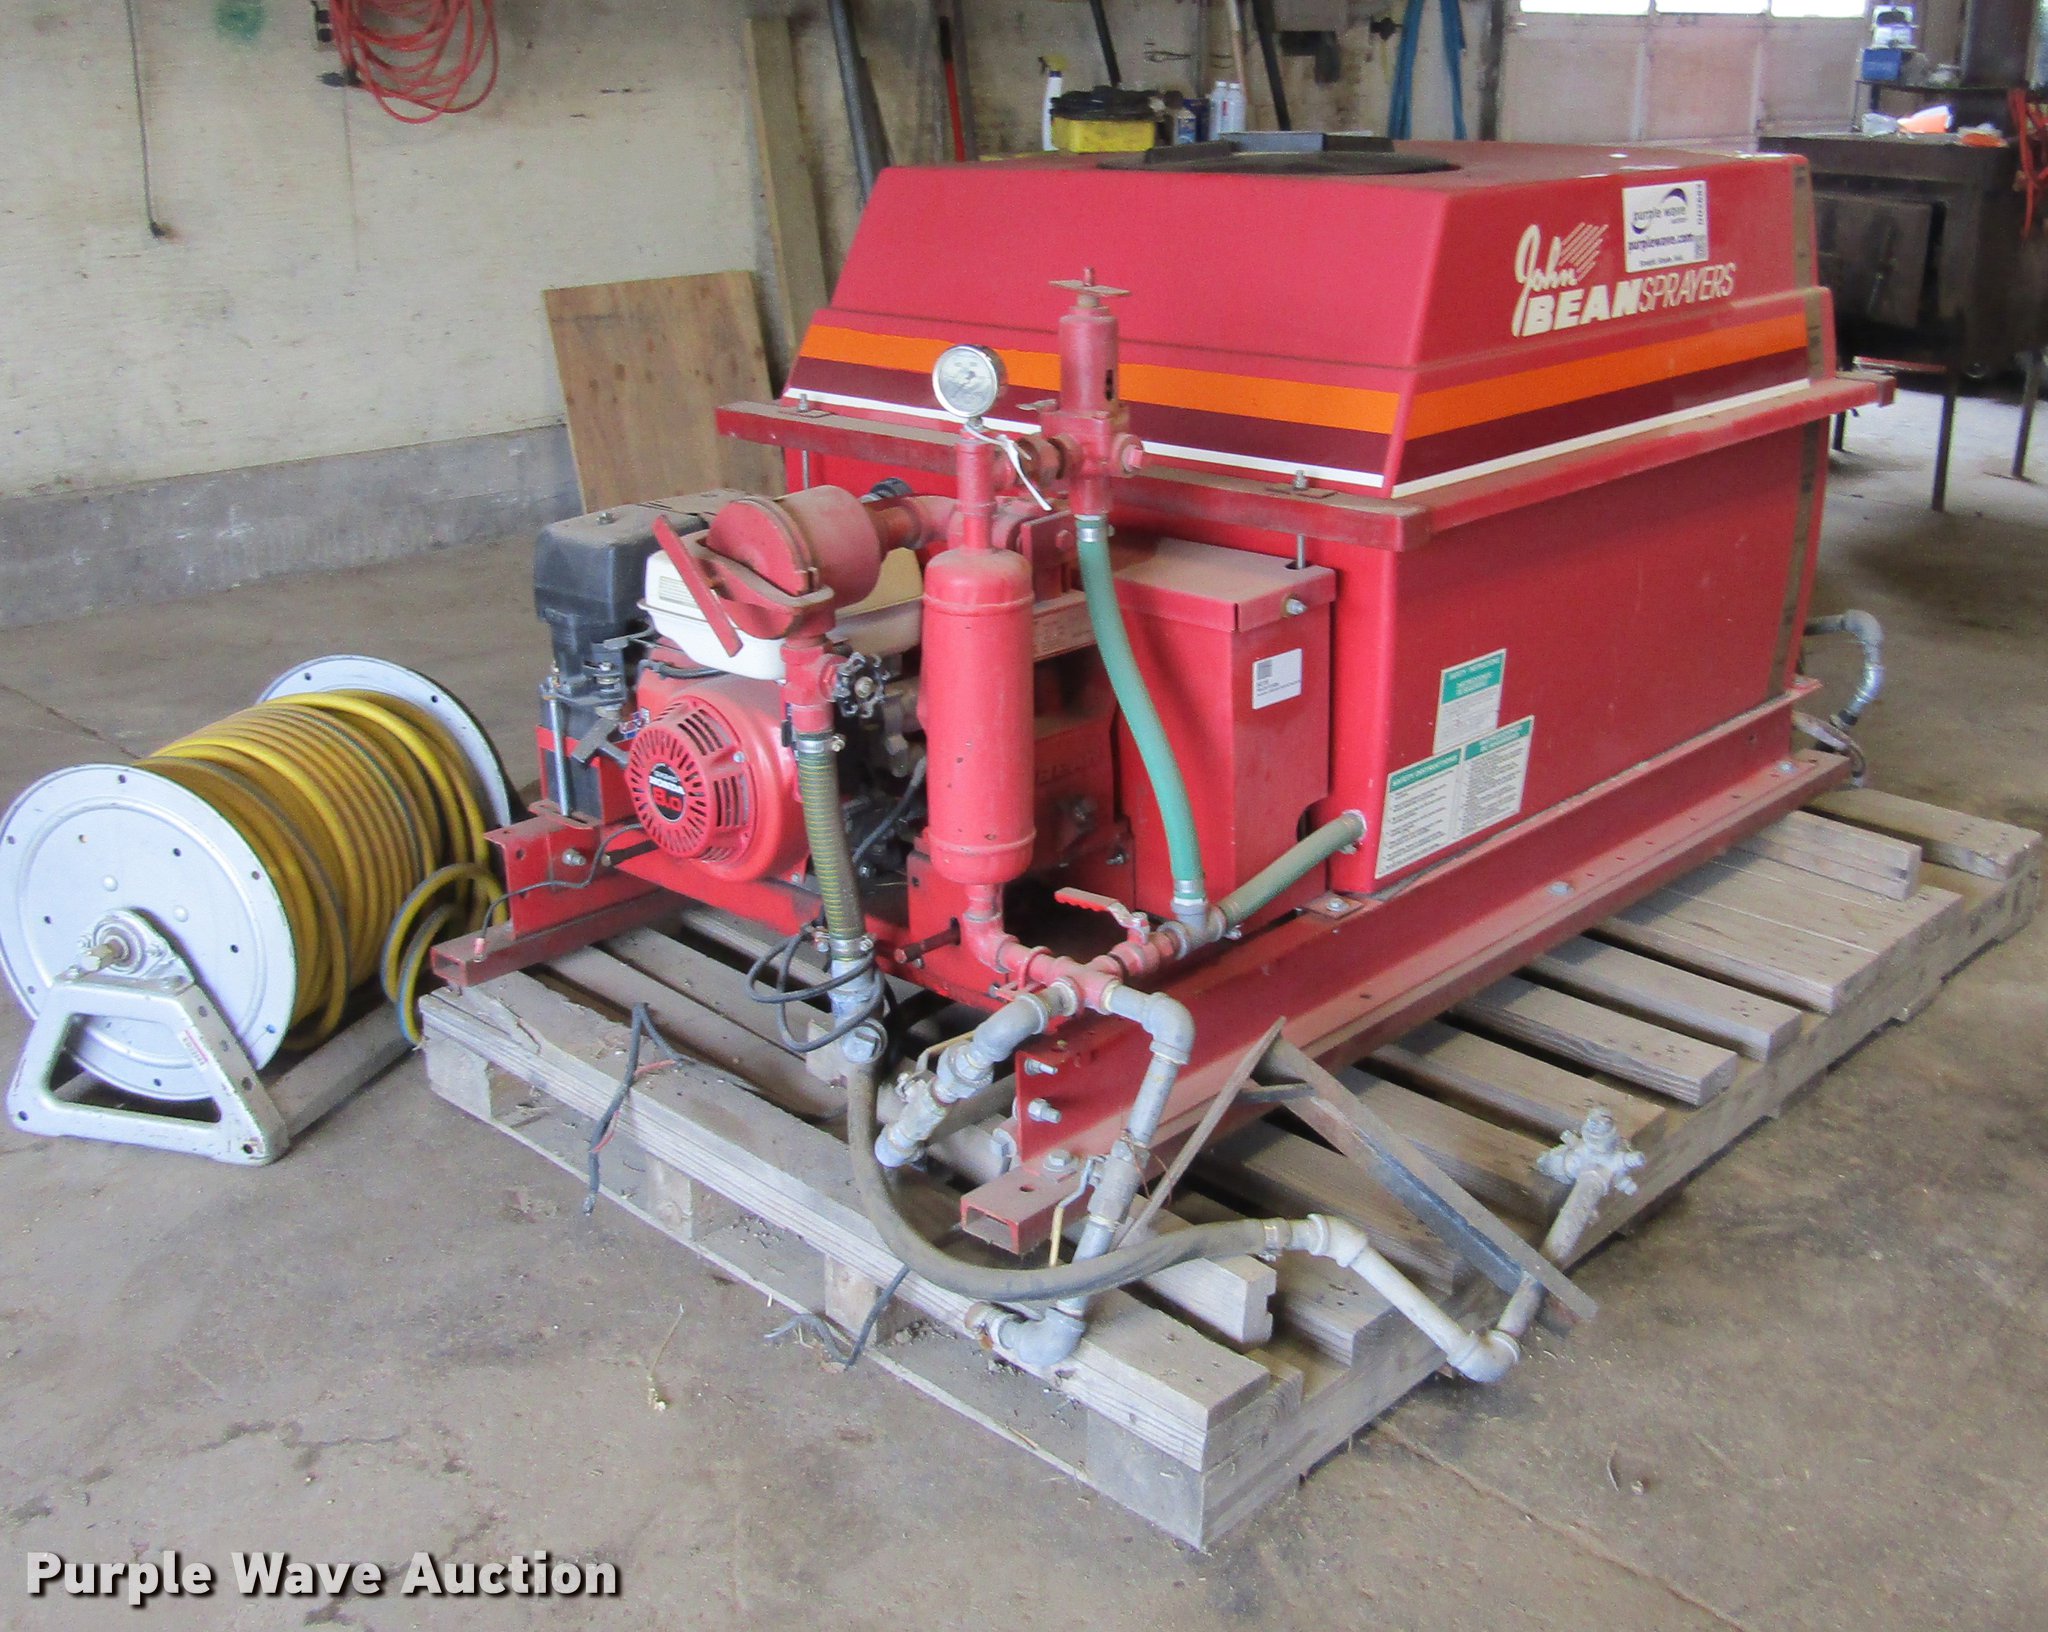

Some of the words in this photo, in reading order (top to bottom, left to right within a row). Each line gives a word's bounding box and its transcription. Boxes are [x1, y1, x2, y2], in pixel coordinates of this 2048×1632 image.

[1513, 224, 1577, 337] John
[1521, 279, 1642, 337] BEAN
[1640, 263, 1736, 312] SPRAYERS
